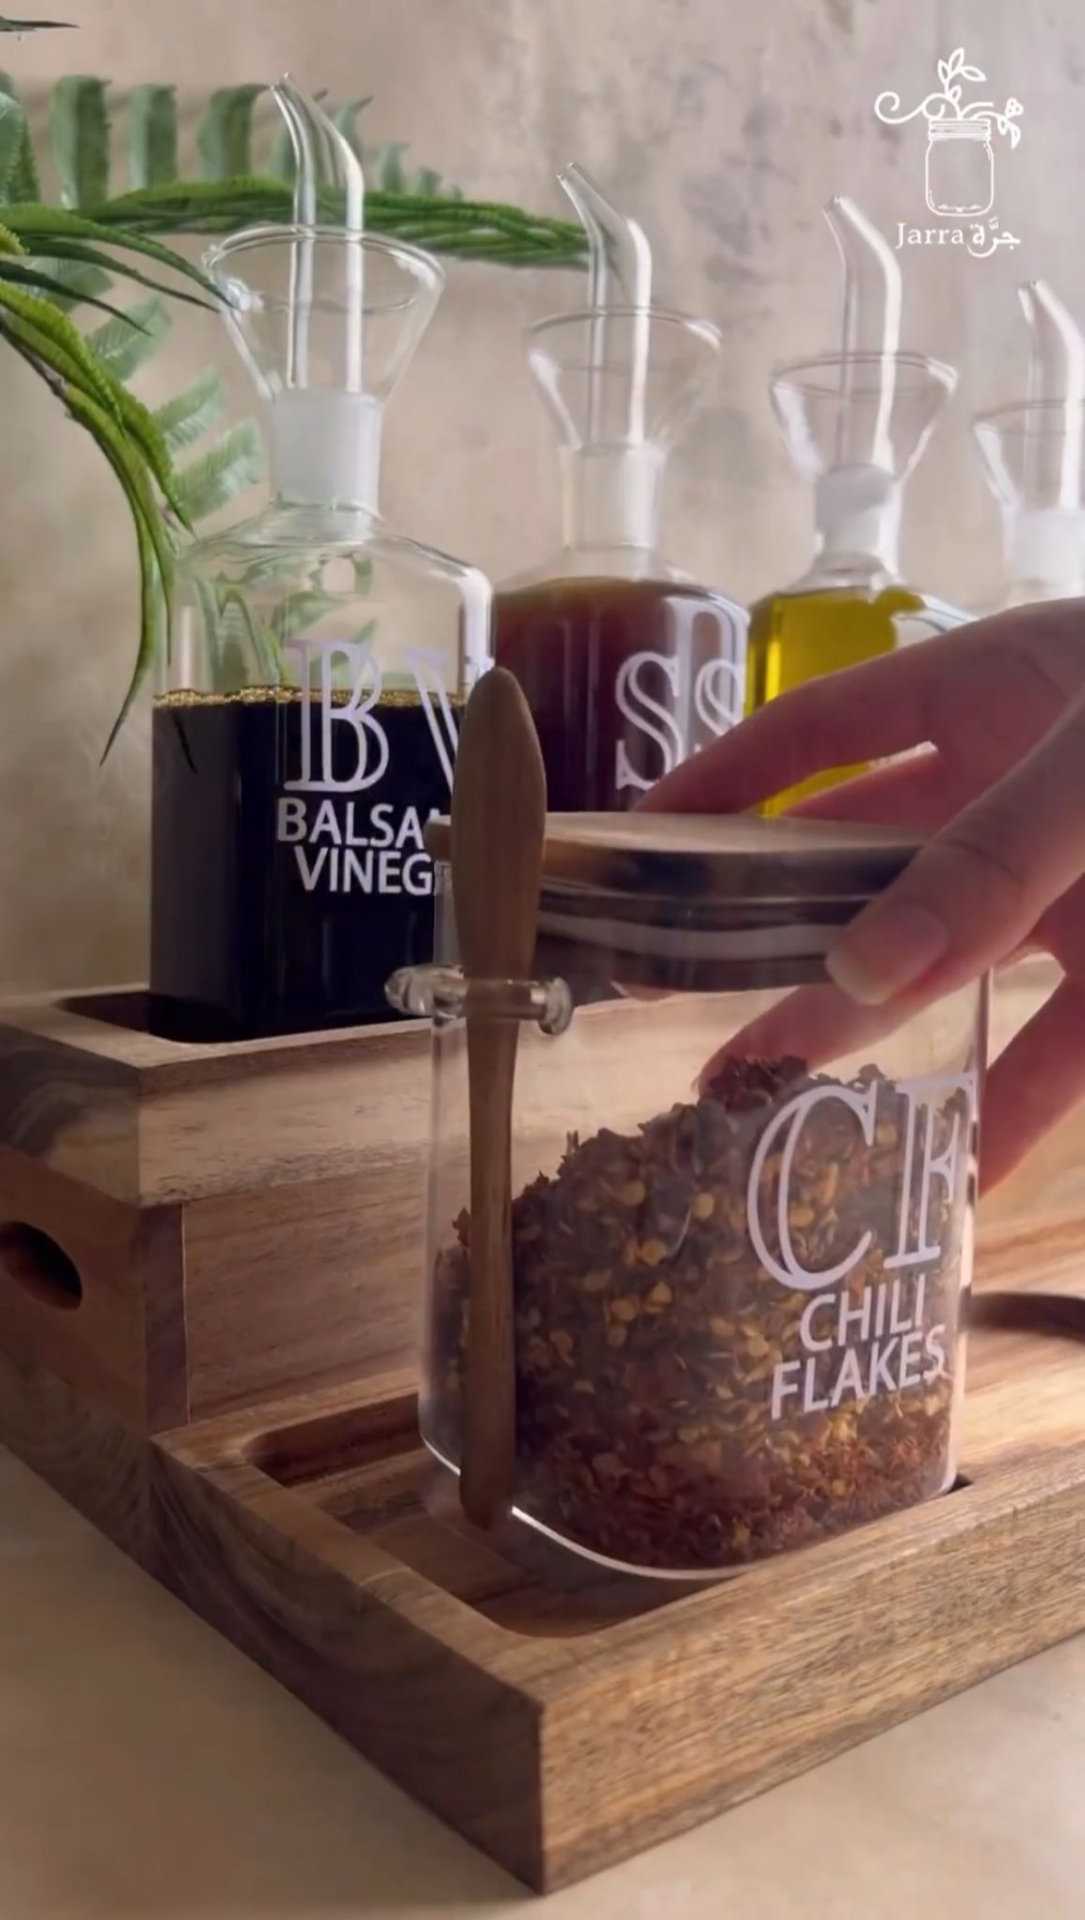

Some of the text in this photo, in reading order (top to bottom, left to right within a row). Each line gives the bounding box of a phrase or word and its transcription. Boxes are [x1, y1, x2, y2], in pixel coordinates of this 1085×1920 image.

[276, 797, 441, 850] BALSA
[747, 1070, 977, 1291] CF
[800, 1273, 926, 1352] CHILI
[770, 1324, 947, 1420] FLAKES
